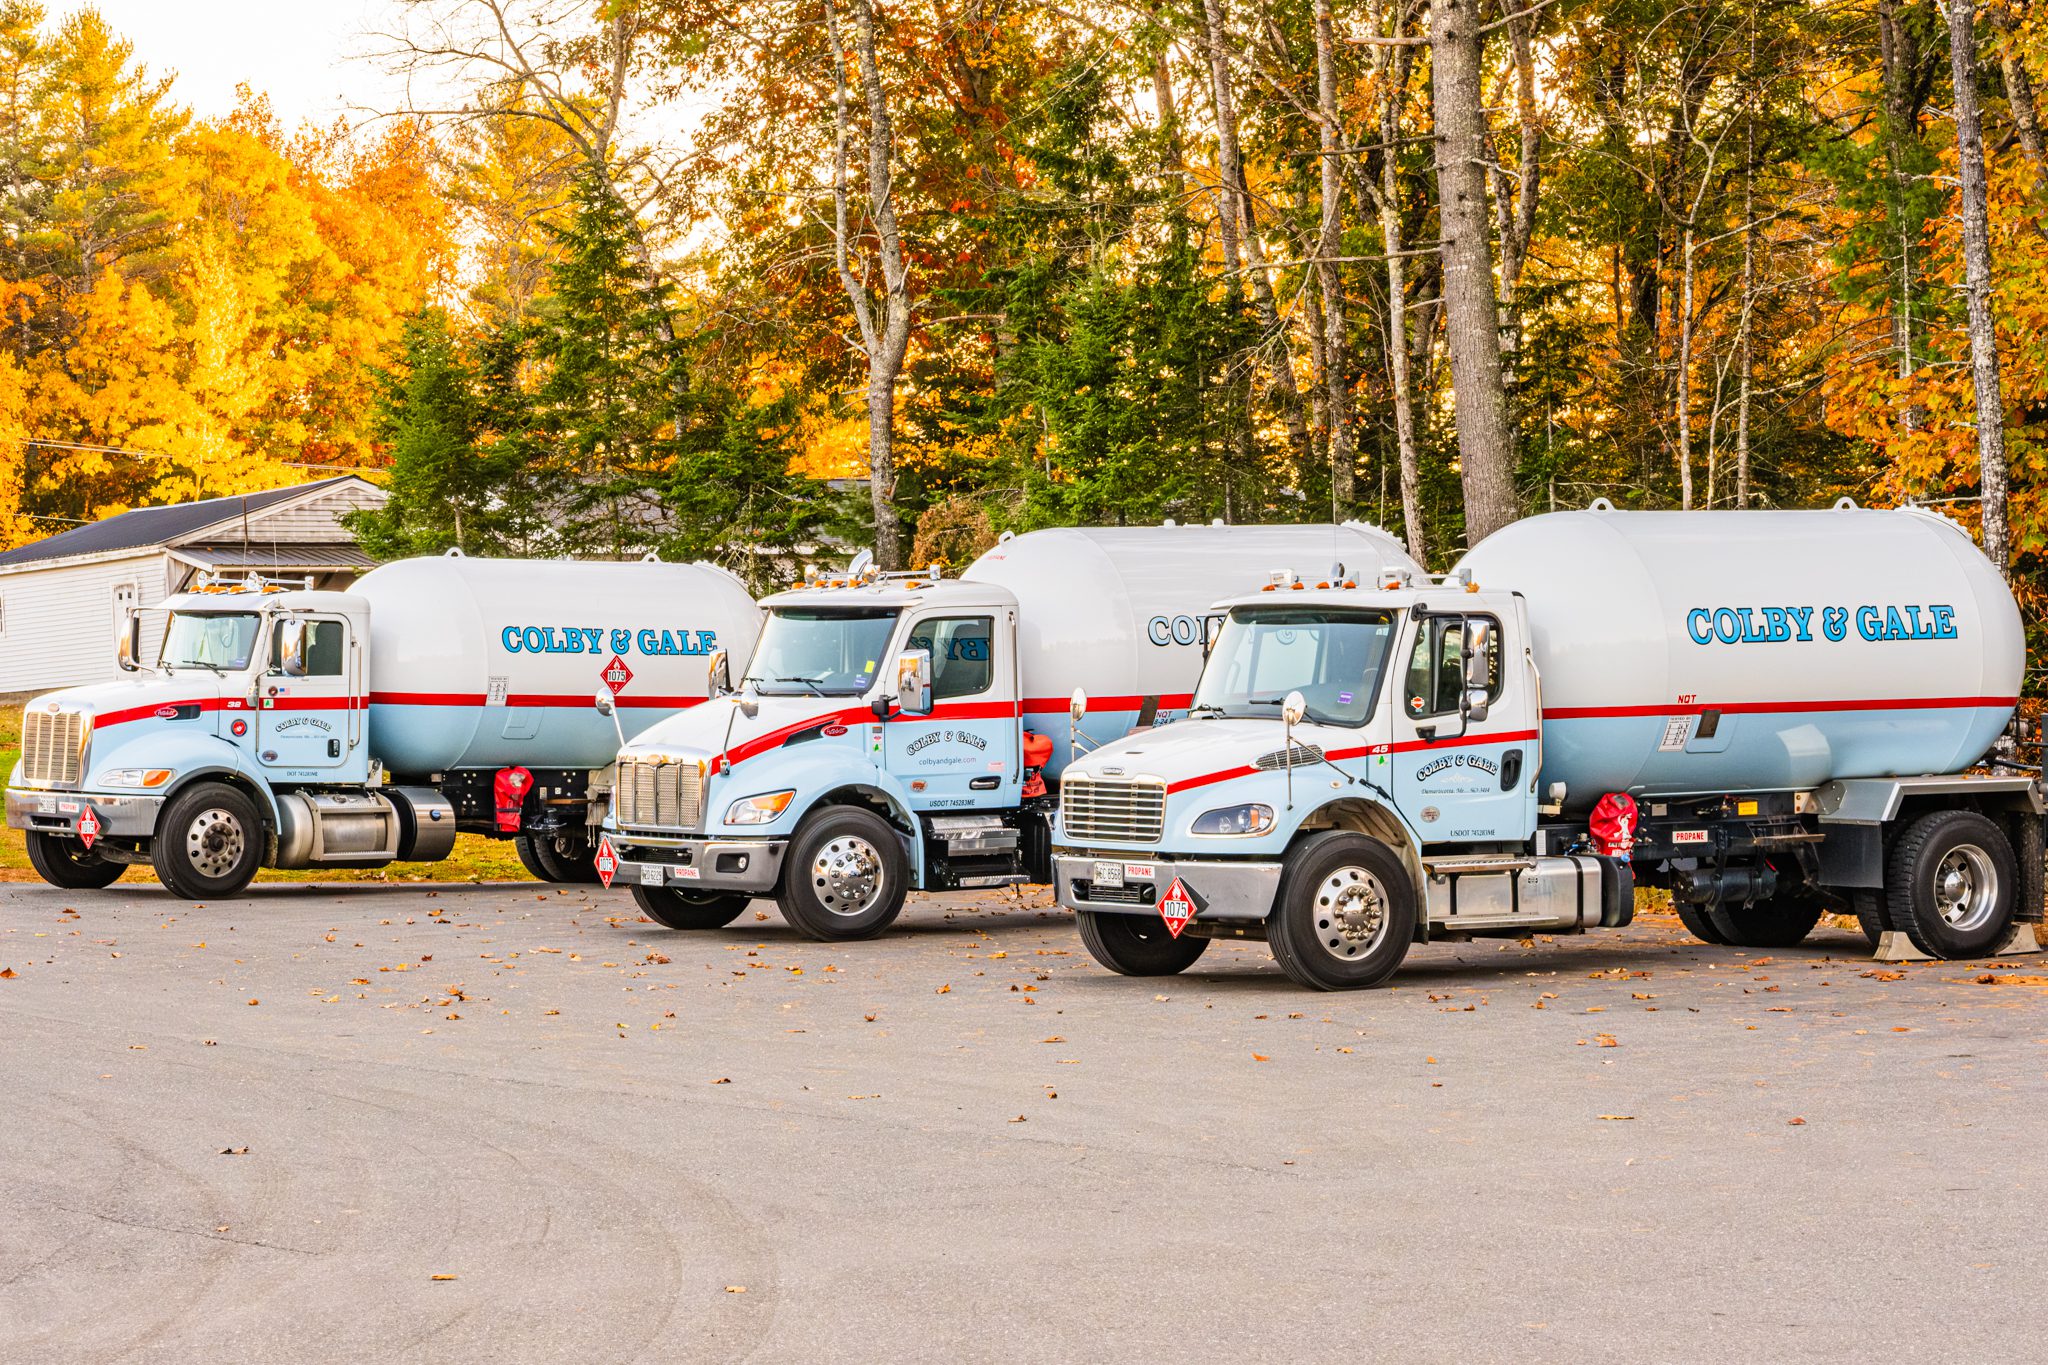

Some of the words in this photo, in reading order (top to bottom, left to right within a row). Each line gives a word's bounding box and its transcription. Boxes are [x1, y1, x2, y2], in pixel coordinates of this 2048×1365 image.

[1686, 606, 1814, 645] COLBY
[1822, 606, 1849, 642] &
[1856, 605, 1958, 642] GALE
[502, 626, 604, 654] COLBY
[610, 629, 632, 655] &
[637, 629, 718, 656] GALE
[607, 670, 626, 682] 1075
[275, 717, 301, 733] COLBY
[310, 717, 332, 733] GALE
[906, 731, 941, 756] COLBY
[944, 730, 954, 742] &
[956, 730, 987, 751] GALE
[1372, 744, 1389, 754] 45
[918, 756, 977, 767] colbyandgale.com
[1416, 755, 1454, 782] COLBY
[1455, 754, 1465, 767] &
[1467, 754, 1499, 776] GALE
[1450, 829, 1470, 837] USDOT
[1675, 831, 1705, 841] PROPANE
[600, 857, 612, 871] 1075
[676, 868, 696, 878] PROPANE
[1127, 866, 1153, 877] PROPANE
[1166, 901, 1187, 918] 1075
[1172, 921, 1179, 929] 2
